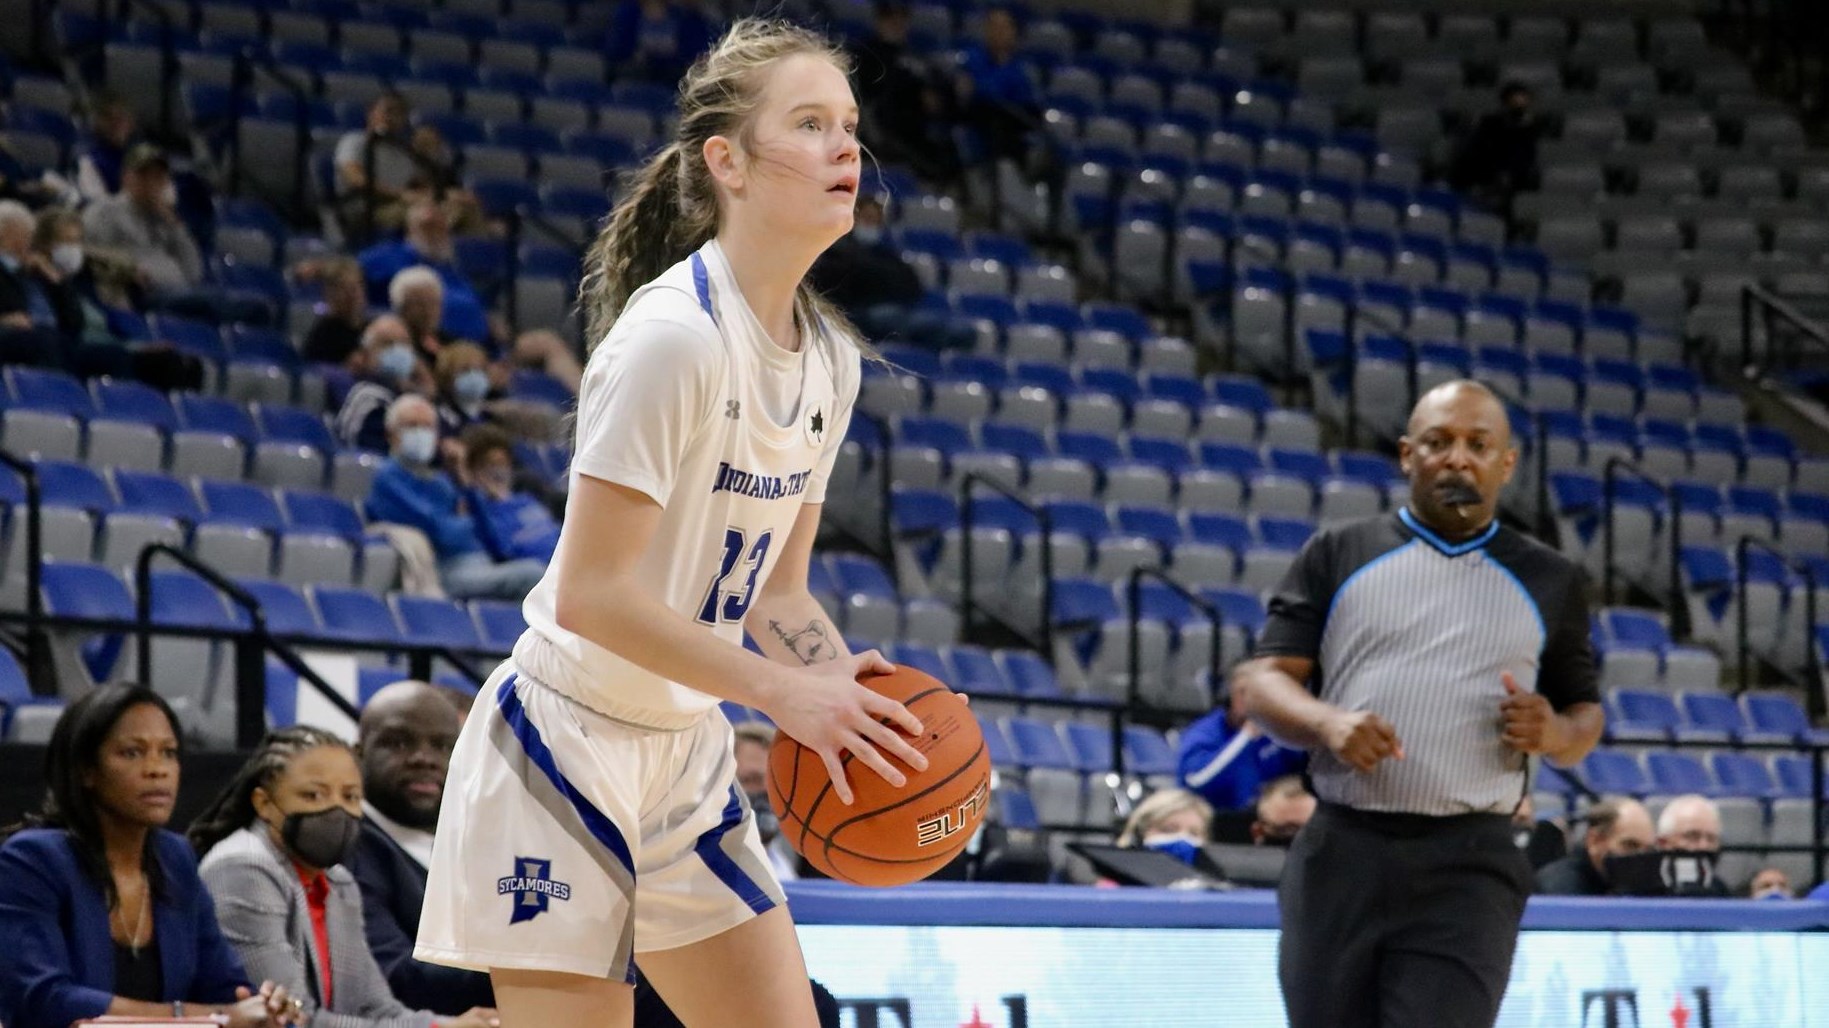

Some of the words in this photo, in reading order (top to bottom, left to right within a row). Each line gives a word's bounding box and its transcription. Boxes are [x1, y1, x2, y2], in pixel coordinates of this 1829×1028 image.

[711, 461, 782, 500] INDIANA
[777, 468, 813, 498] TAT
[498, 876, 570, 900] SYCAMORES
